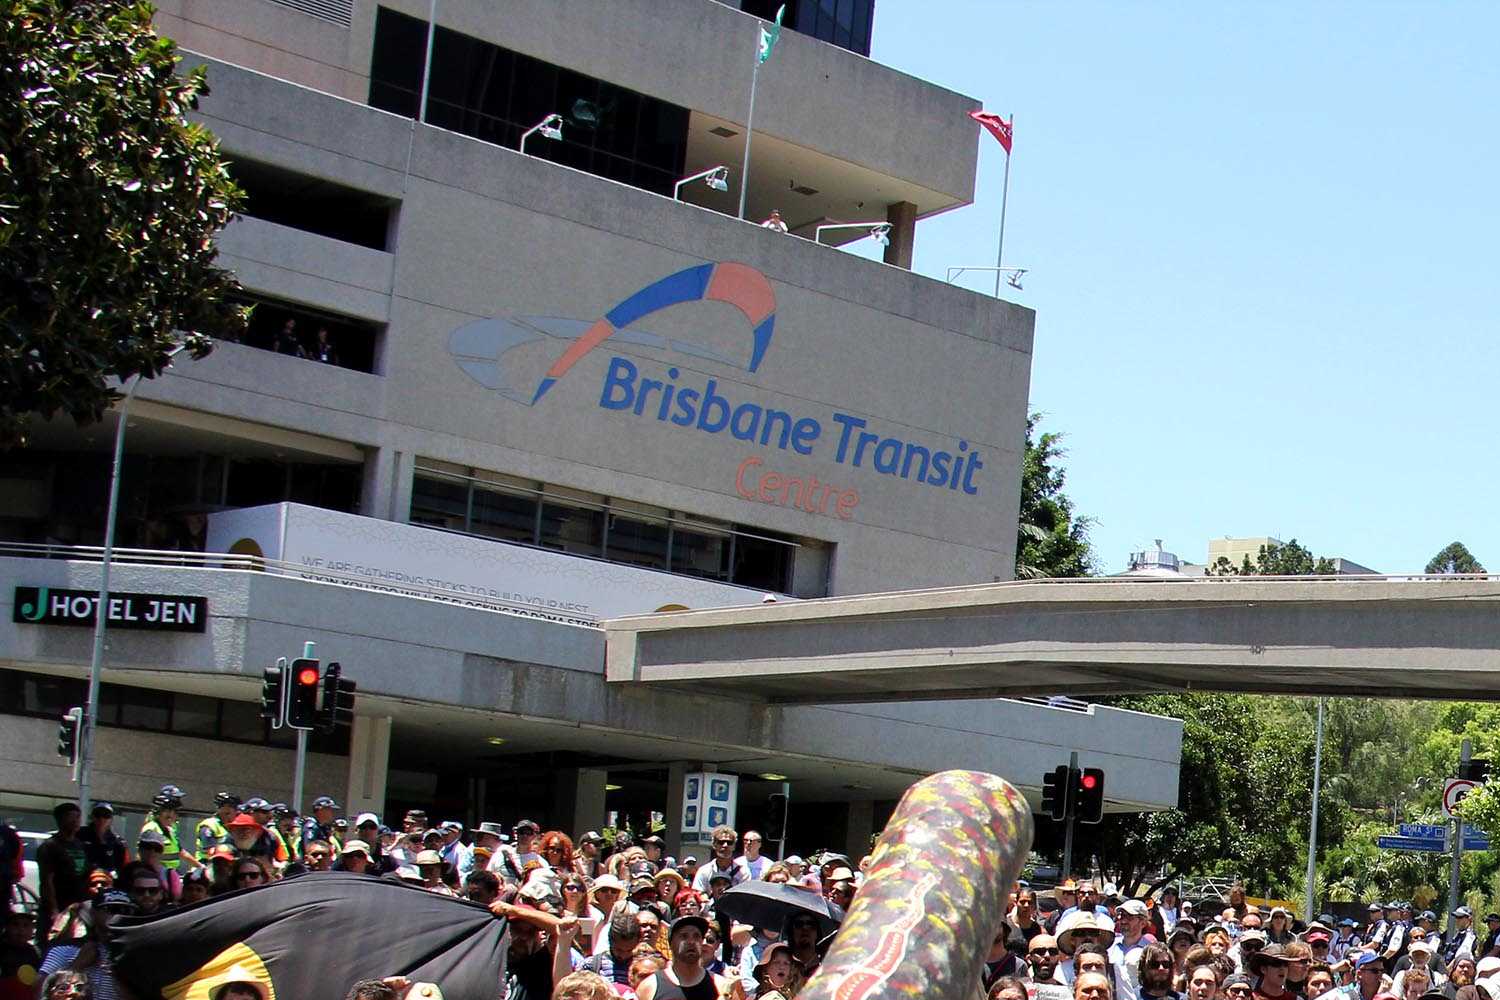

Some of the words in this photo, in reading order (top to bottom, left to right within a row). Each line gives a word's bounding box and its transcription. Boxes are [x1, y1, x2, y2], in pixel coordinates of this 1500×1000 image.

[599, 356, 821, 456] Brisbane
[832, 413, 984, 495] Transit
[735, 455, 860, 521] Centre
[52, 595, 138, 621] HOTEL
[145, 600, 197, 624] JEN
